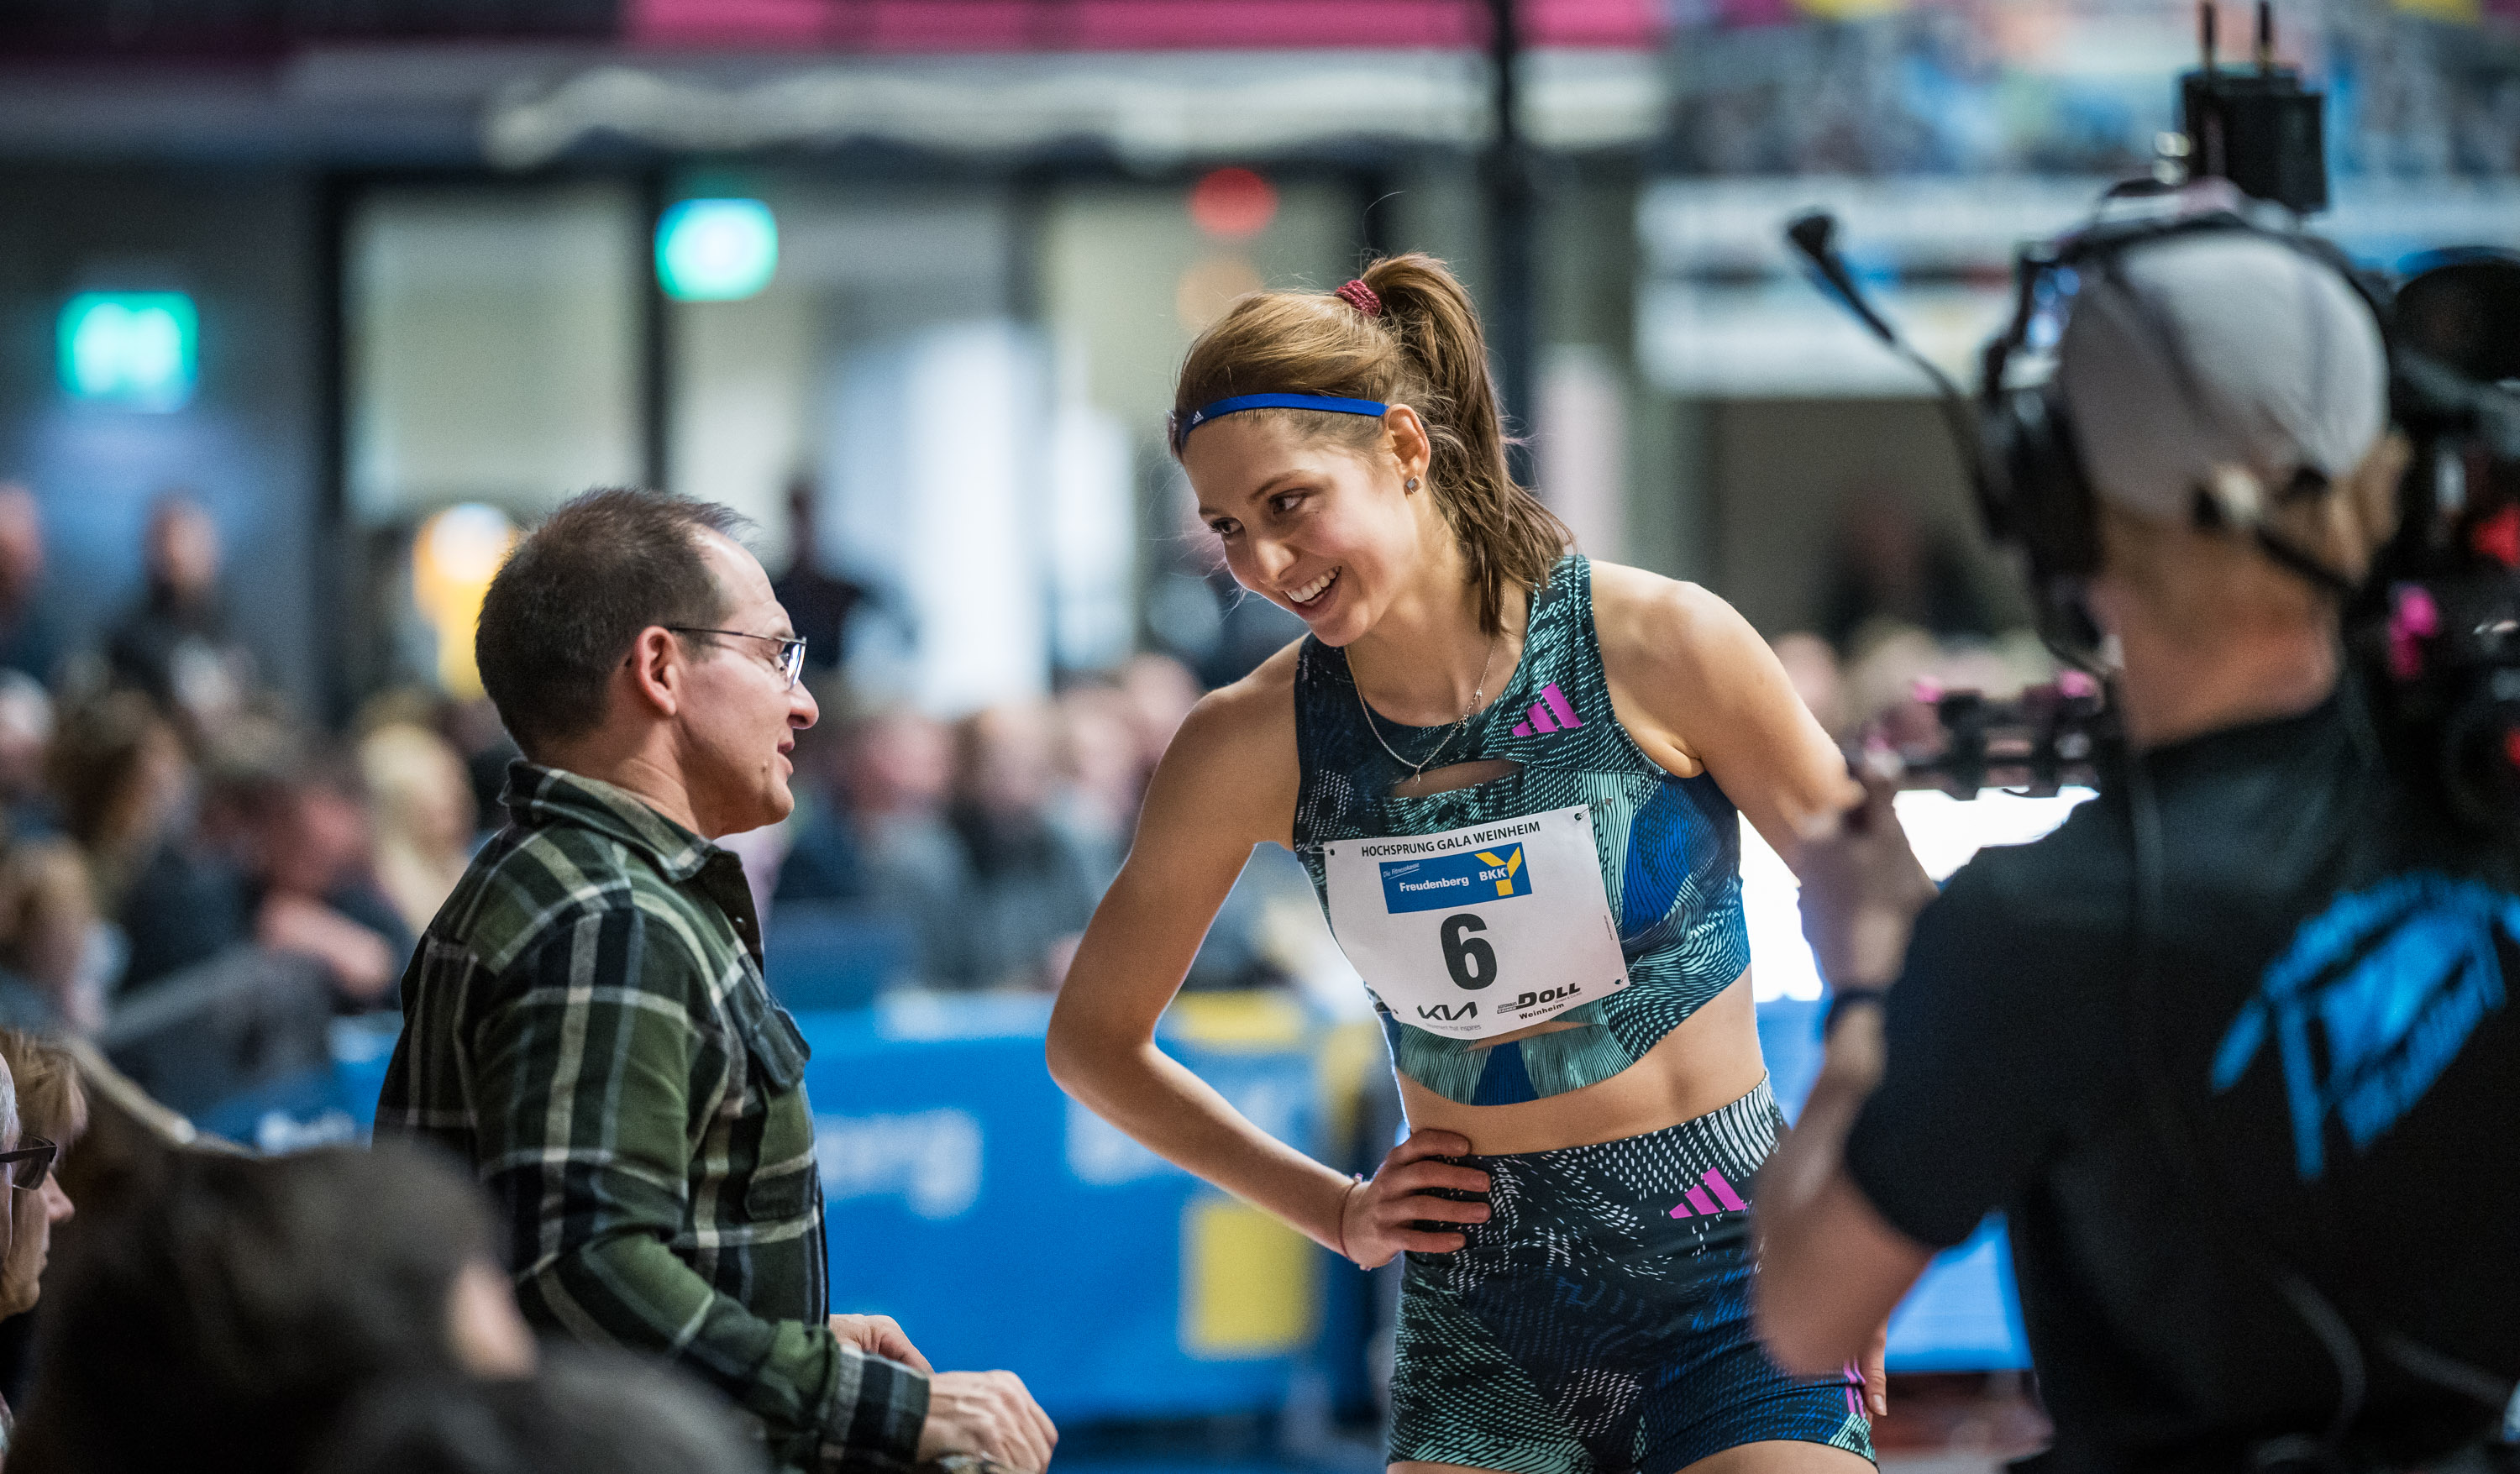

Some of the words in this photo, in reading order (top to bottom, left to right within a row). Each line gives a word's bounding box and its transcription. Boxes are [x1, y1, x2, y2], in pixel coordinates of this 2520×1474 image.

[1361, 841, 1435, 858] HOCHSPRUNG
[1436, 835, 1472, 850] GALA
[1473, 821, 1541, 844] WEINHEIM
[1399, 876, 1470, 893] Freudenberg
[1478, 867, 1508, 882] BKK
[1440, 913, 1498, 990] 6
[1517, 982, 1581, 1010] DOLL
[1416, 1001, 1478, 1021] KIA
[1519, 1003, 1565, 1020] Weinheim
